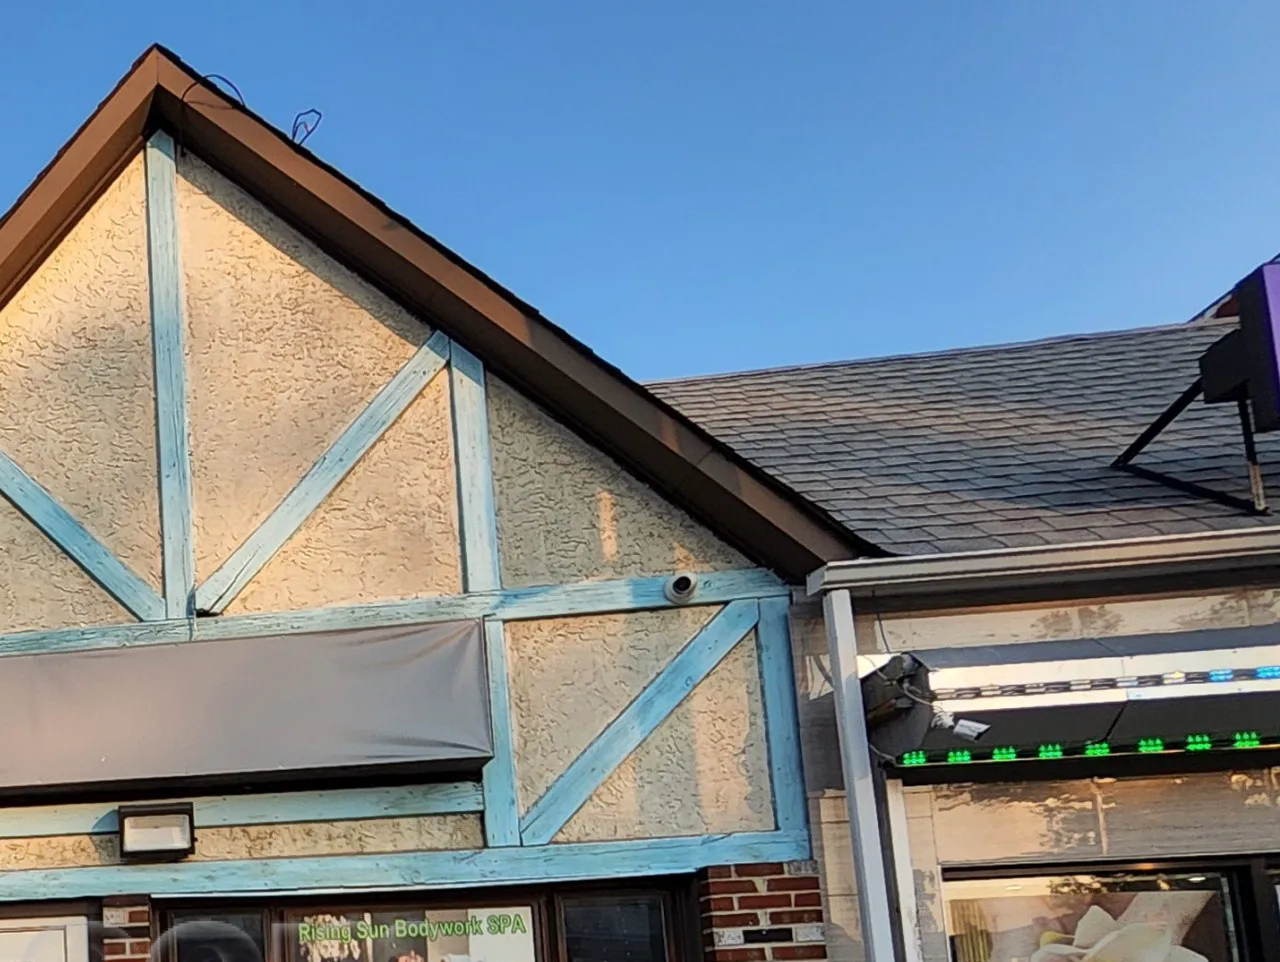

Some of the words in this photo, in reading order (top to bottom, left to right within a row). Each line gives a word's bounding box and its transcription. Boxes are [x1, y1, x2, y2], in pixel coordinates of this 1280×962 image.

[298, 921, 352, 944] Rising
[356, 920, 390, 940] Sun
[395, 916, 483, 942] Bodywork
[486, 914, 527, 935] SPA
